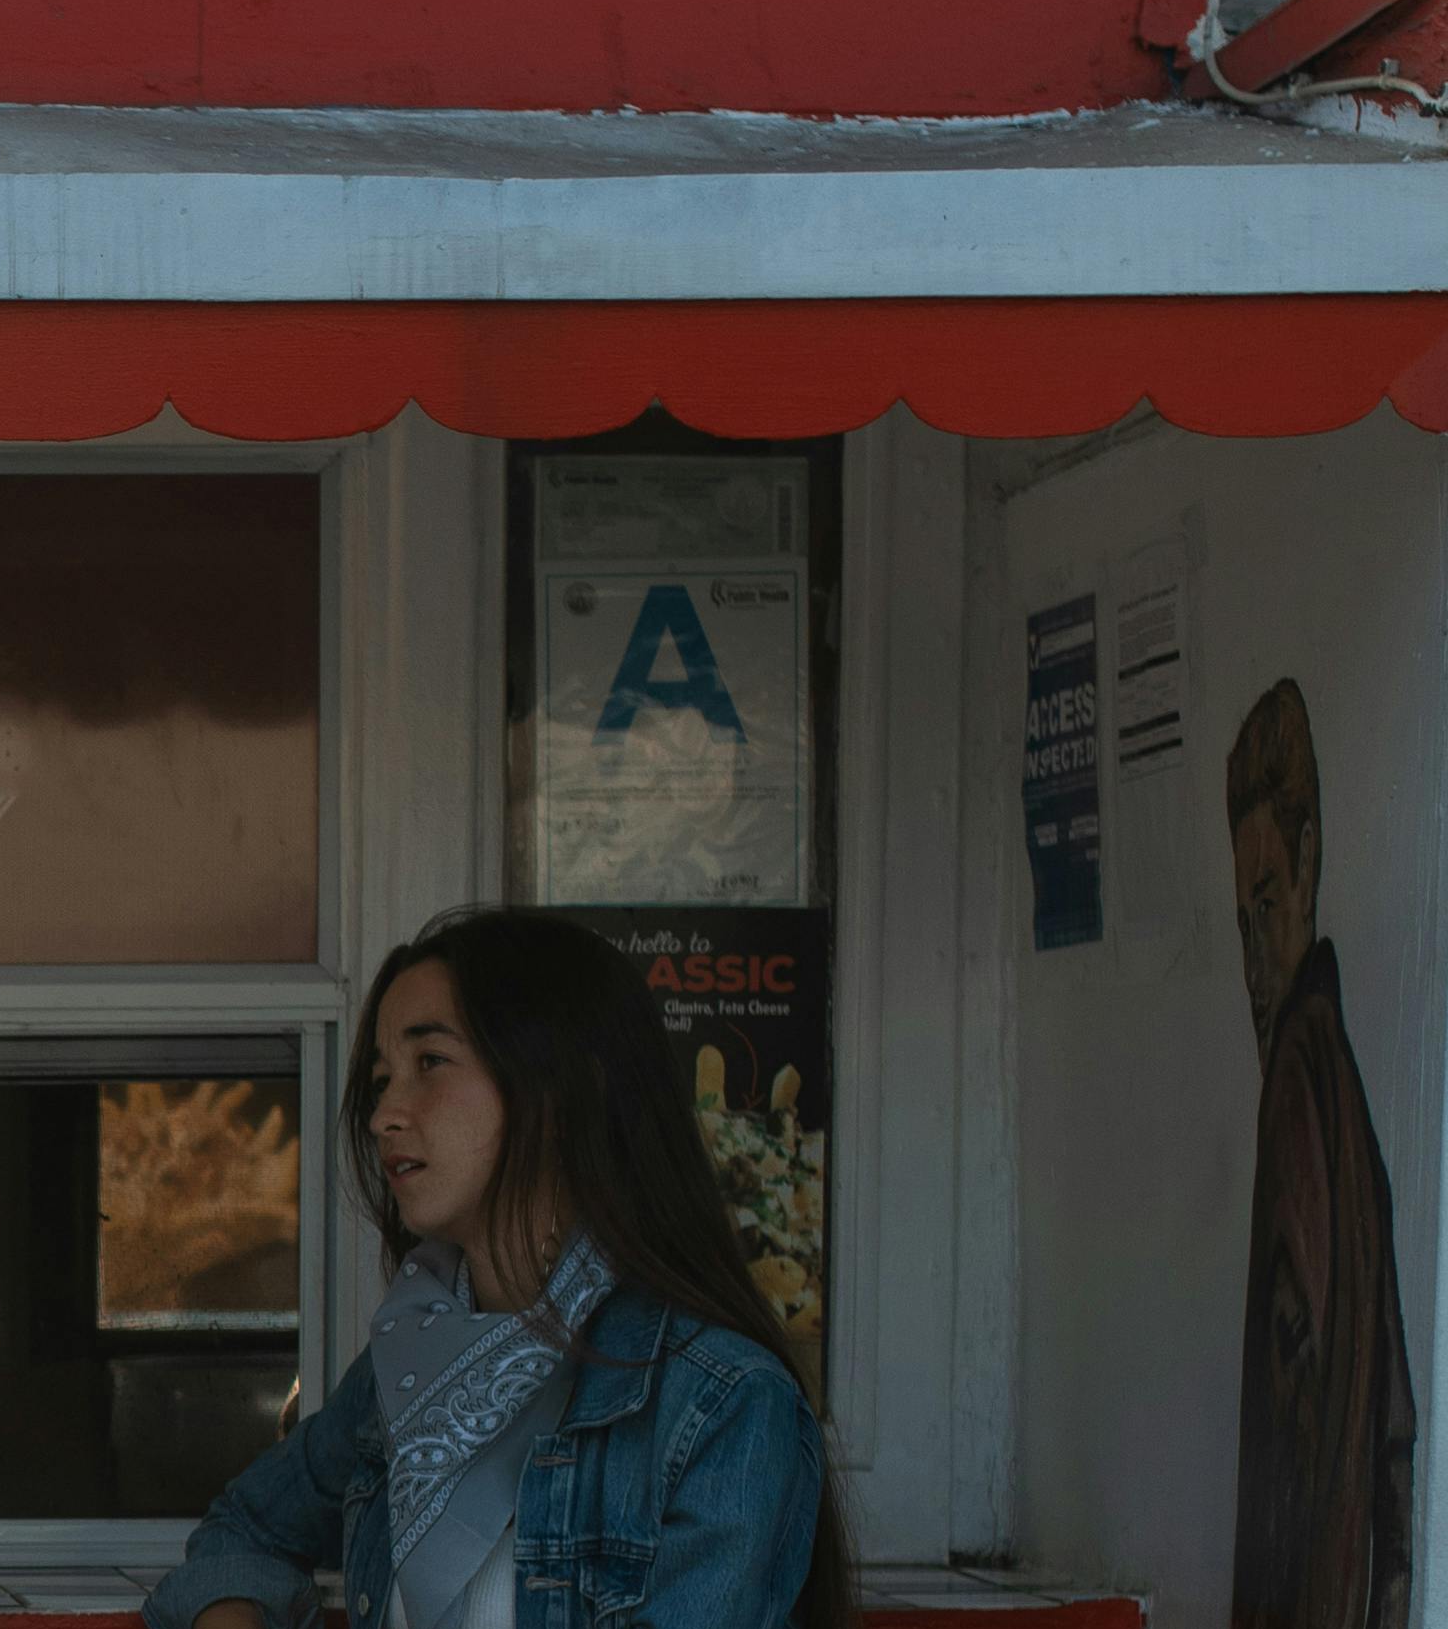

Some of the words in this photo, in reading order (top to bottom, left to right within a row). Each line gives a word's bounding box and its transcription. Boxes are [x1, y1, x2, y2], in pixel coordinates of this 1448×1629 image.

[591, 585, 749, 746] A
[628, 929, 682, 954] hello
[689, 931, 712, 954] to
[645, 954, 796, 993] ASSIC
